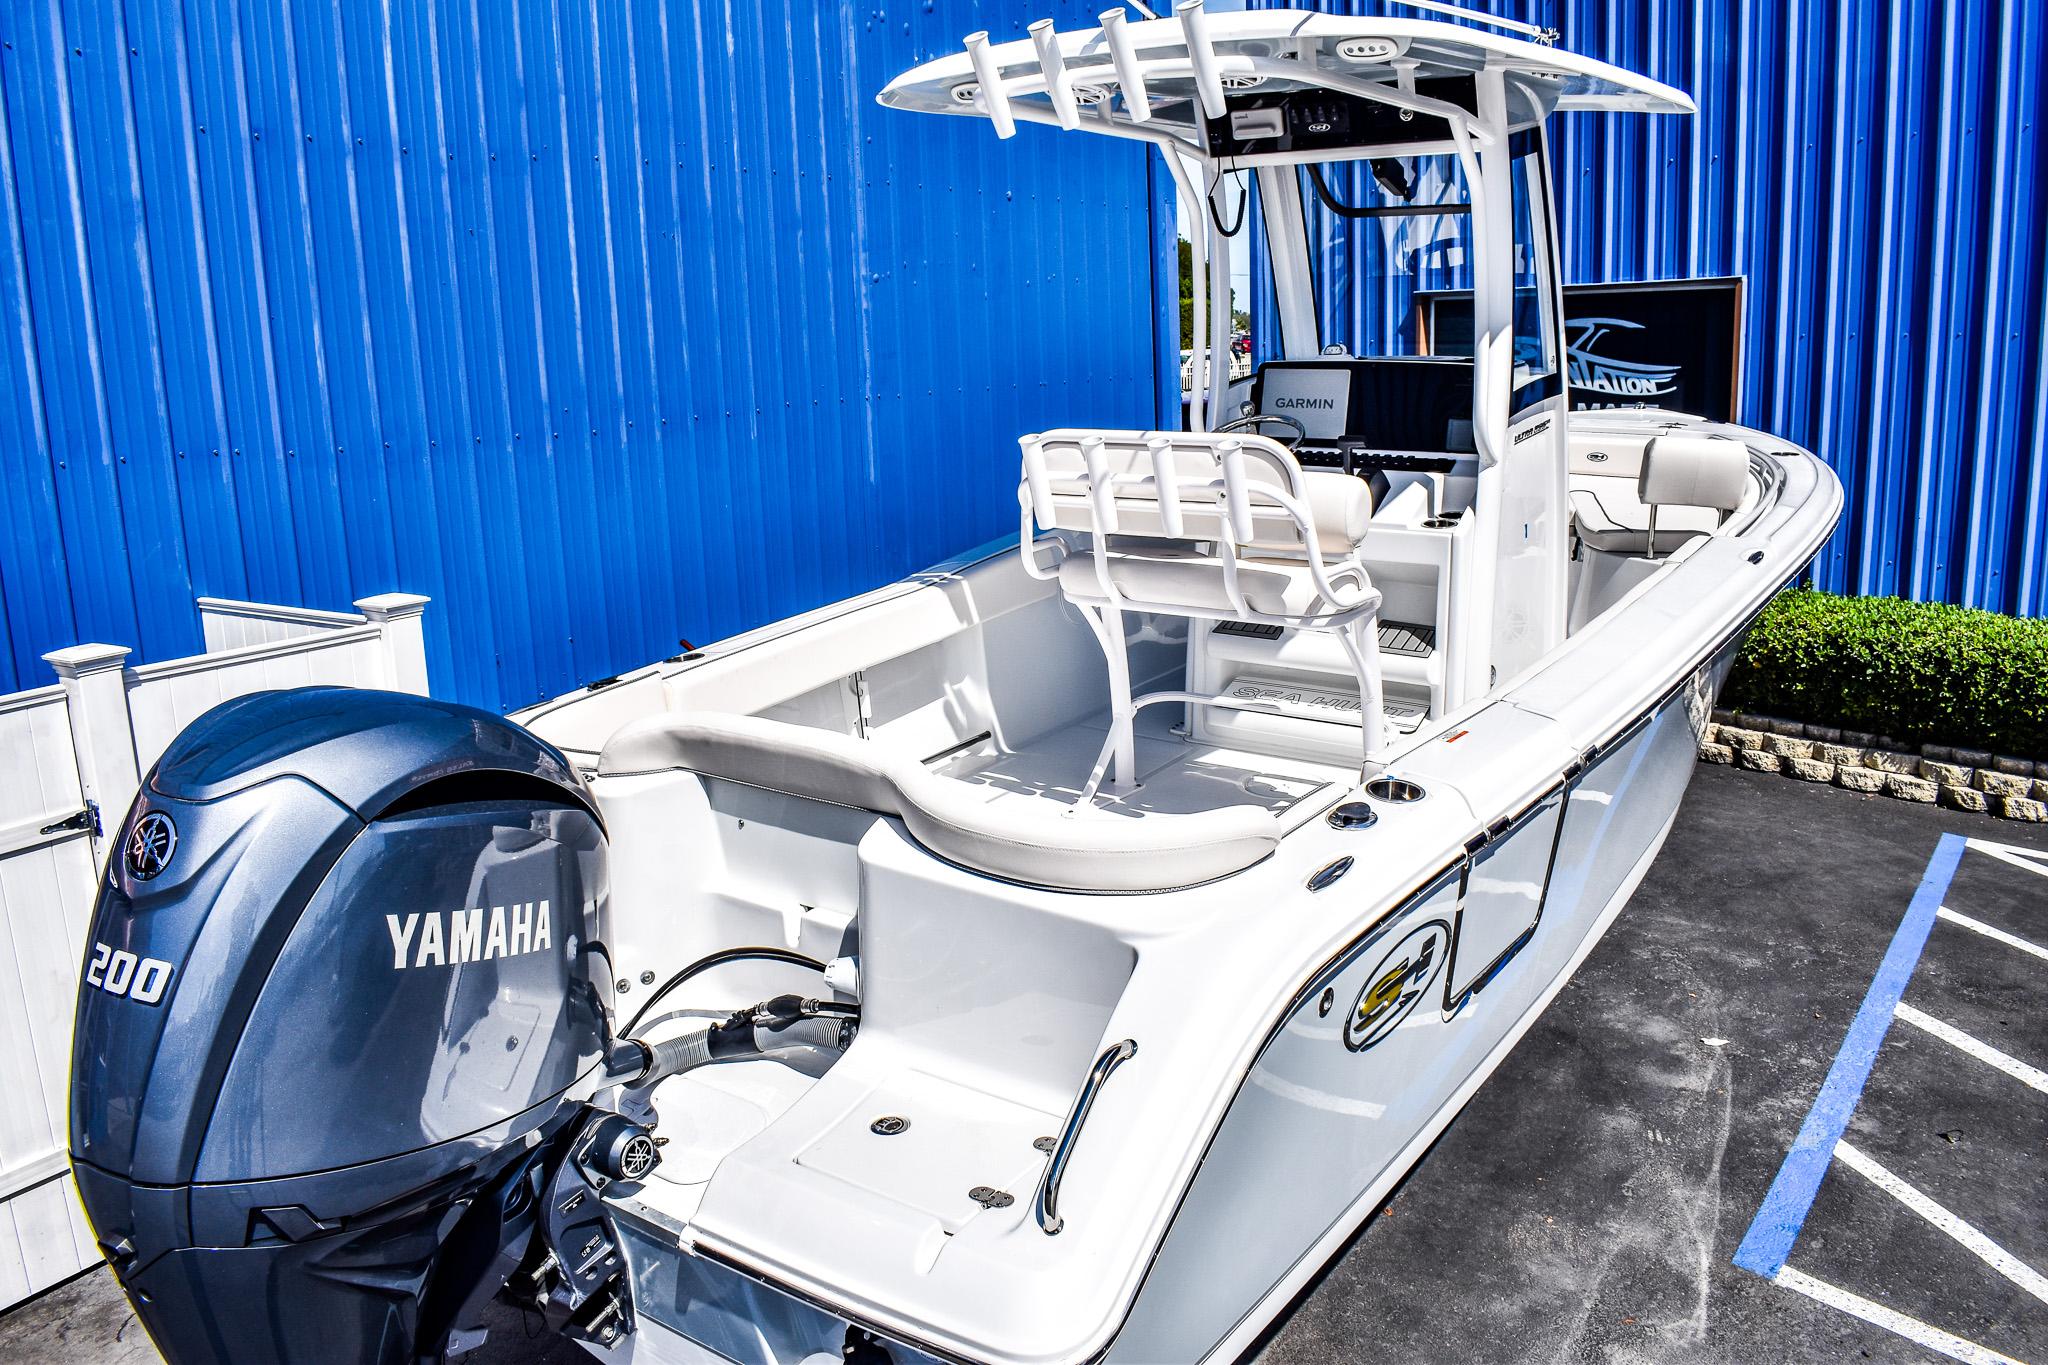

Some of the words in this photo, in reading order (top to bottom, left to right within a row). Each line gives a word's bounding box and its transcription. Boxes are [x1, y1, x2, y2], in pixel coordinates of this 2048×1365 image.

[1566, 358, 1658, 395] NTATION
[1275, 397, 1335, 410] GARMIN
[386, 899, 552, 970] YAMAHA
[86, 941, 173, 1004] 200
